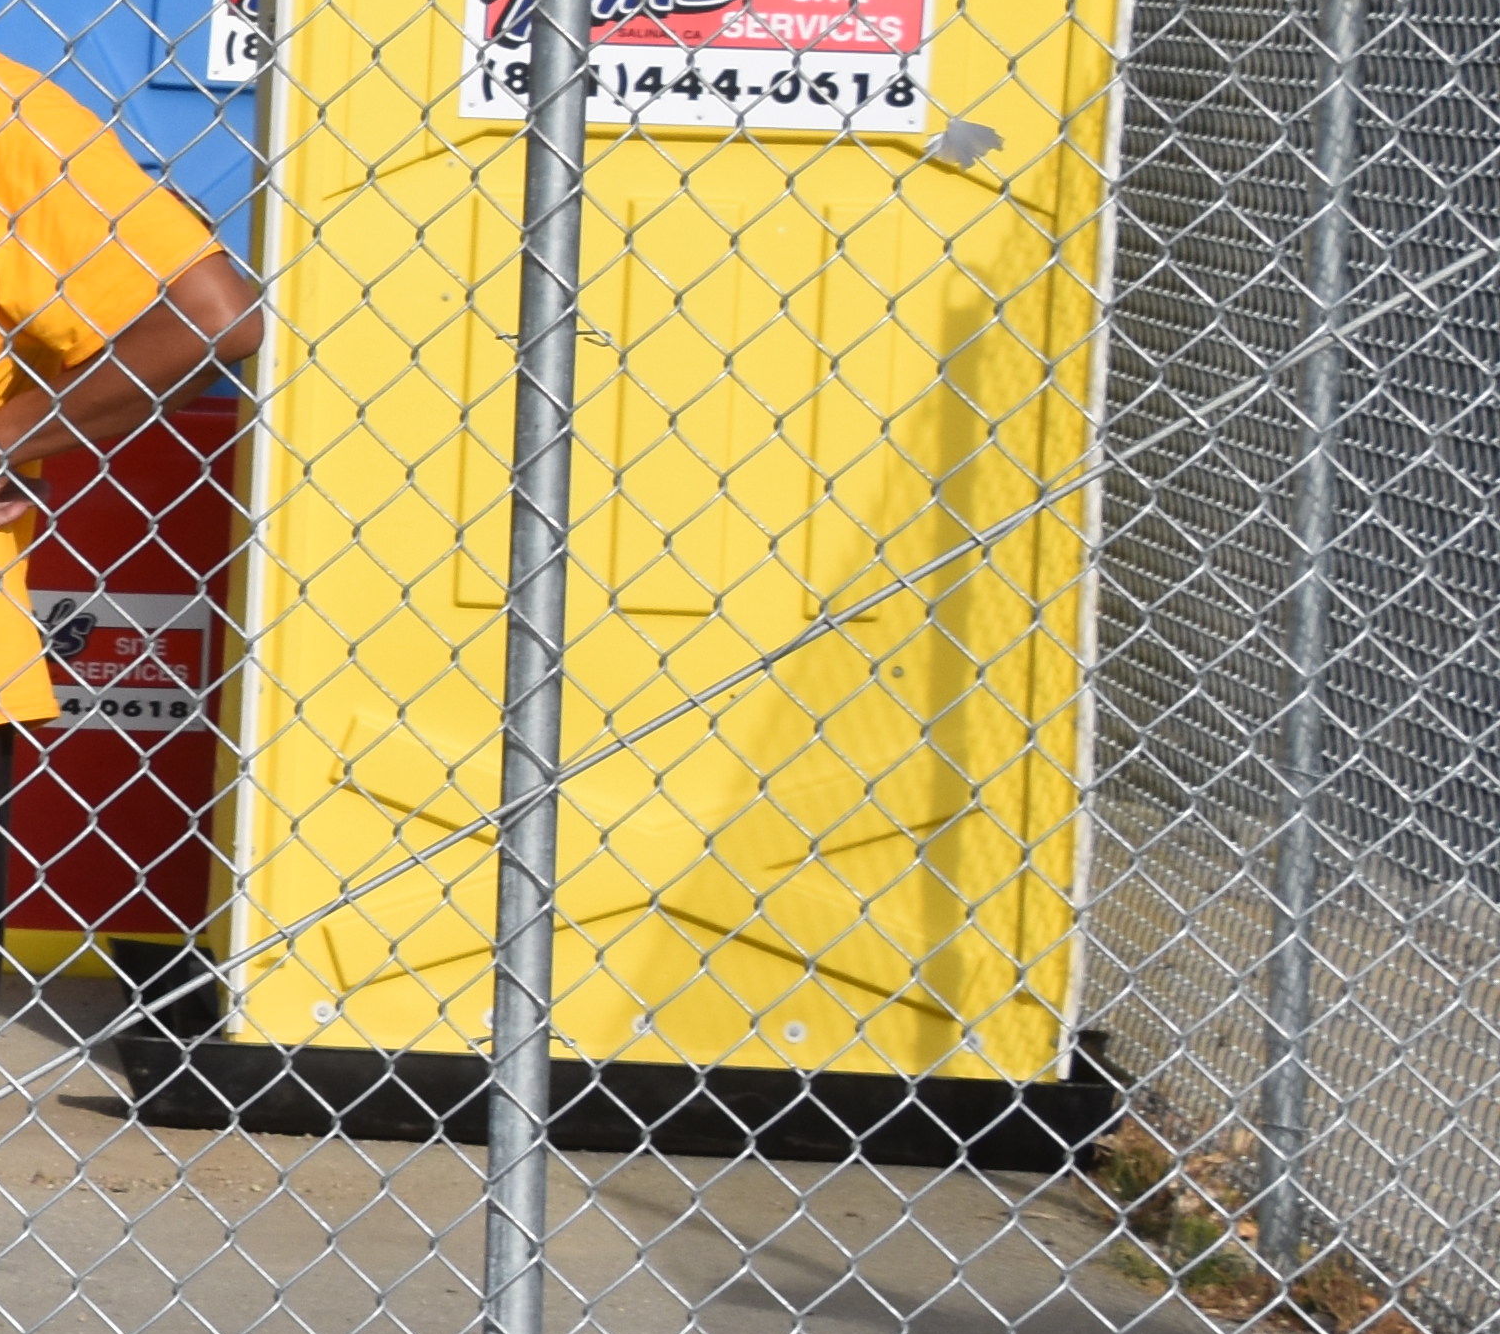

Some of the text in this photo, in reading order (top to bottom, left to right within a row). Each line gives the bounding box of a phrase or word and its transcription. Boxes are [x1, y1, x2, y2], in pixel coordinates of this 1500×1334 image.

[720, 11, 905, 44] SERVICES
[482, 58, 917, 108] (81)444-0618
[114, 636, 168, 657] SITE
[71, 661, 190, 683] SERVICES
